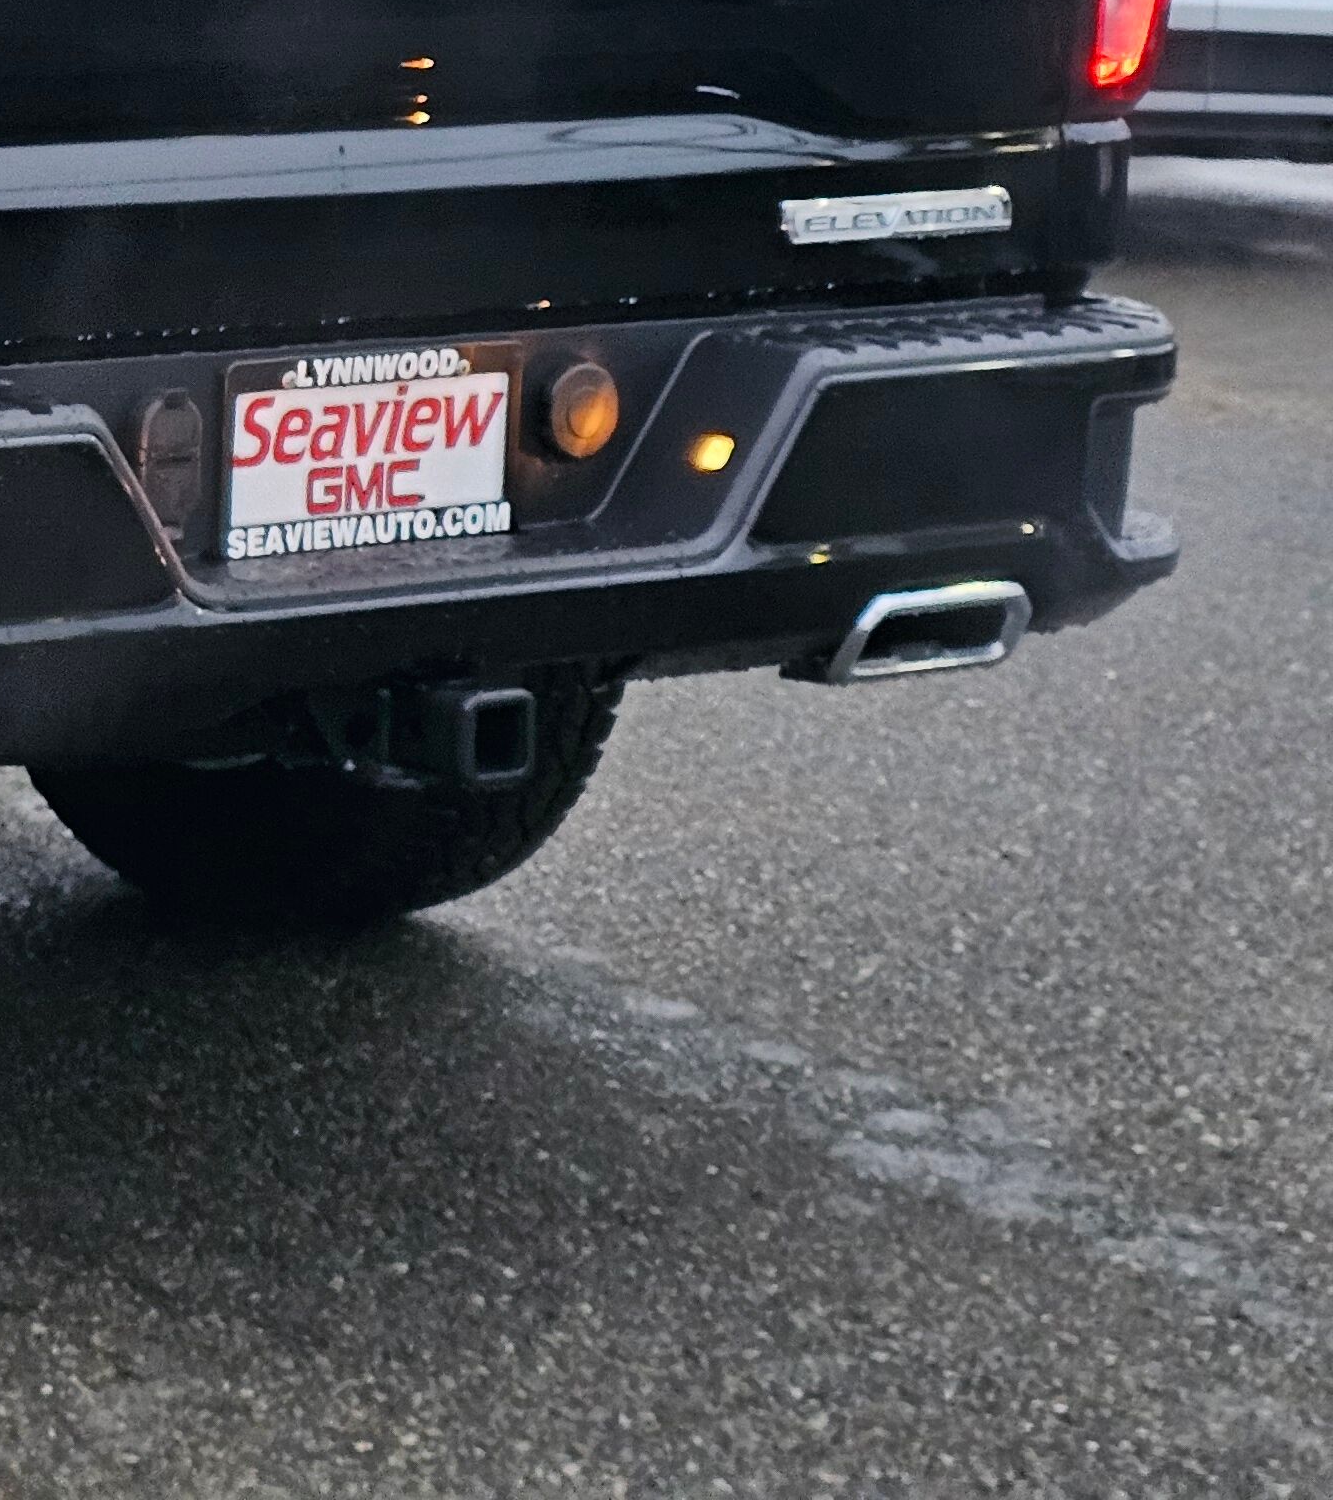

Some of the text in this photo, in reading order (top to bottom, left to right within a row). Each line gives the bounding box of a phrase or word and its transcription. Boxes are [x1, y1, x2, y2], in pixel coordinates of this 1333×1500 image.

[803, 204, 997, 233] ELEVATION
[295, 348, 459, 388] LYNNWOOD
[233, 383, 504, 468] Seaview
[306, 459, 426, 516] GMC
[227, 500, 512, 560] SEAVIEWAUTO.COM
